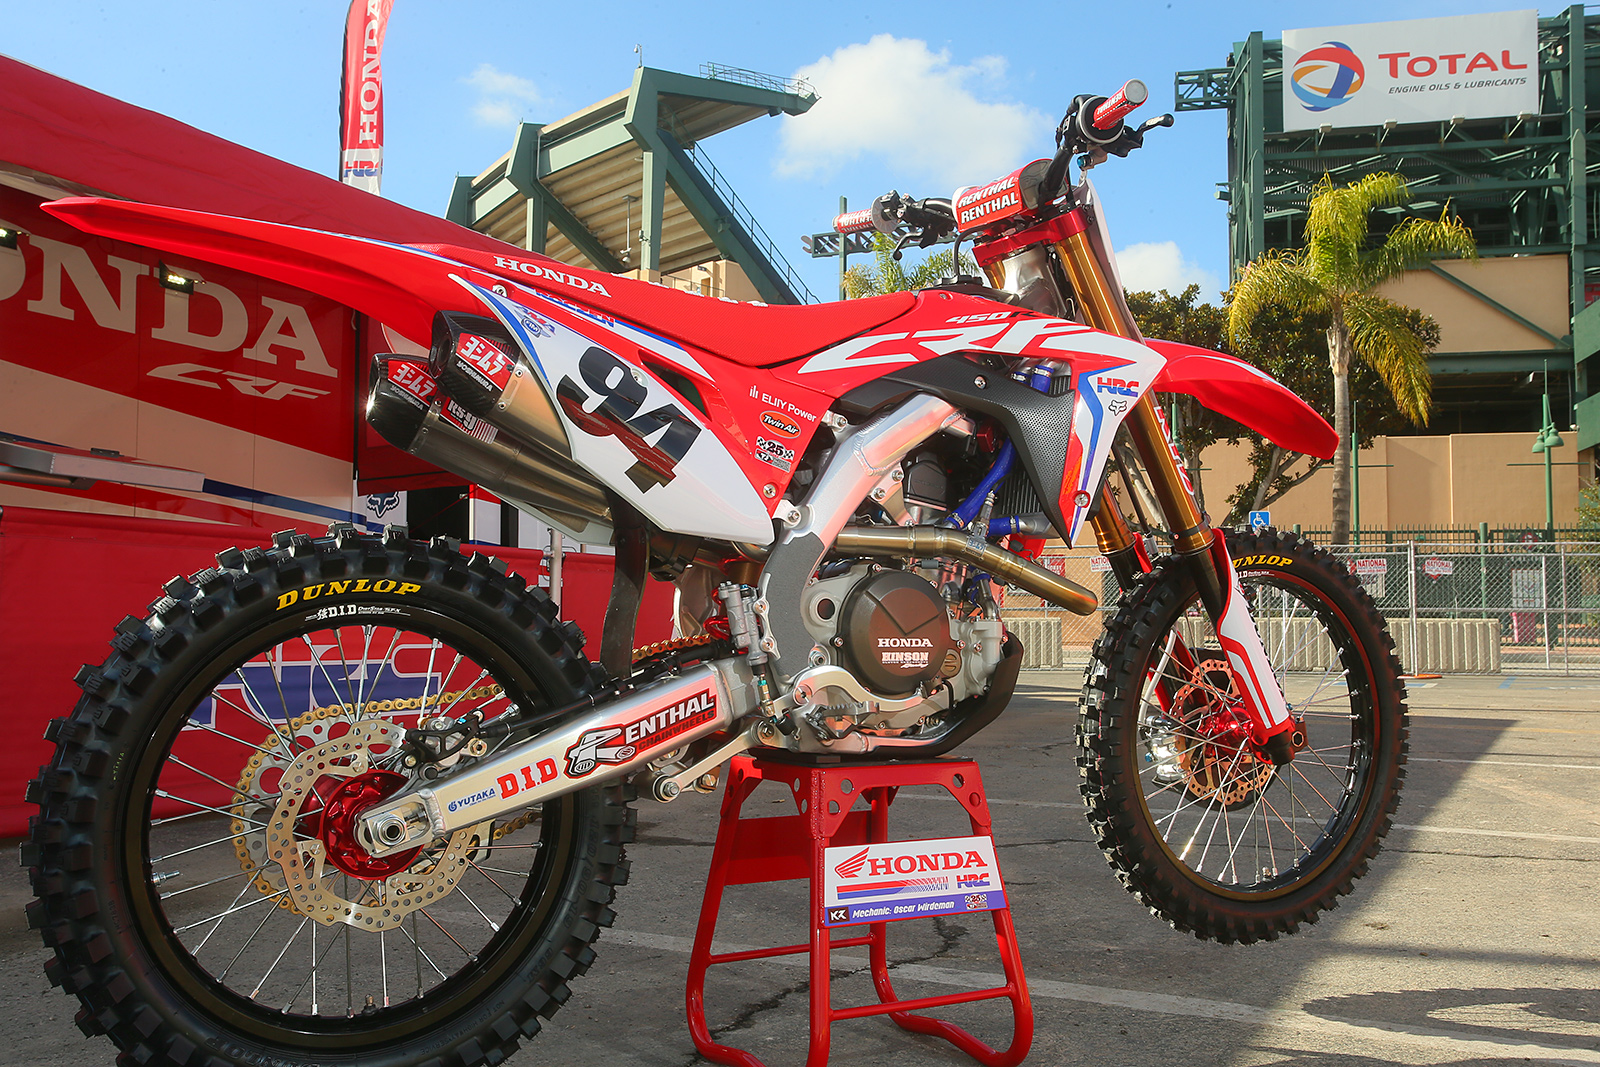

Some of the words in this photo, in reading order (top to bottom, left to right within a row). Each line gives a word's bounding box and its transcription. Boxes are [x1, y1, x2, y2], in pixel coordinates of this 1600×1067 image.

[1378, 50, 1528, 79] TOTAL
[1388, 84, 1426, 95] ENGINE
[1428, 82, 1450, 91] OILS
[1453, 82, 1462, 90] &
[1464, 77, 1527, 89] LUBRICANTS
[958, 175, 1016, 209] RENTHAL
[961, 192, 1019, 224] RENTHAL
[493, 256, 612, 298] HONDA
[460, 336, 506, 376] ヨシムラ
[797, 319, 1093, 374] CRF
[146, 362, 332, 400] CRF
[392, 363, 436, 398] ヨシムラ
[456, 360, 494, 392] YOSHIMURA
[1097, 376, 1139, 398] HRC
[390, 385, 425, 411] YOSHIMURA
[556, 346, 703, 494] 94
[763, 414, 785, 430] Twin
[784, 424, 800, 435] Air
[787, 403, 817, 422] Power
[766, 441, 784, 457] 25
[1232, 554, 1294, 569] UNLOP
[1357, 559, 1386, 567] NATIONAL
[276, 578, 422, 611] DUNLOP
[327, 604, 357, 618] D.I.D
[877, 637, 934, 648] HONDA
[881, 651, 929, 662] HINSON
[638, 709, 716, 752] CHAINWHEELS
[496, 757, 559, 800] D.I.D
[457, 787, 496, 808] YUTAKA
[868, 850, 988, 876] HONDA
[956, 873, 991, 889] HRC
[852, 906, 892, 918] Mechanic:
[894, 903, 916, 914] Oscar
[917, 901, 955, 912] Wirdeman
